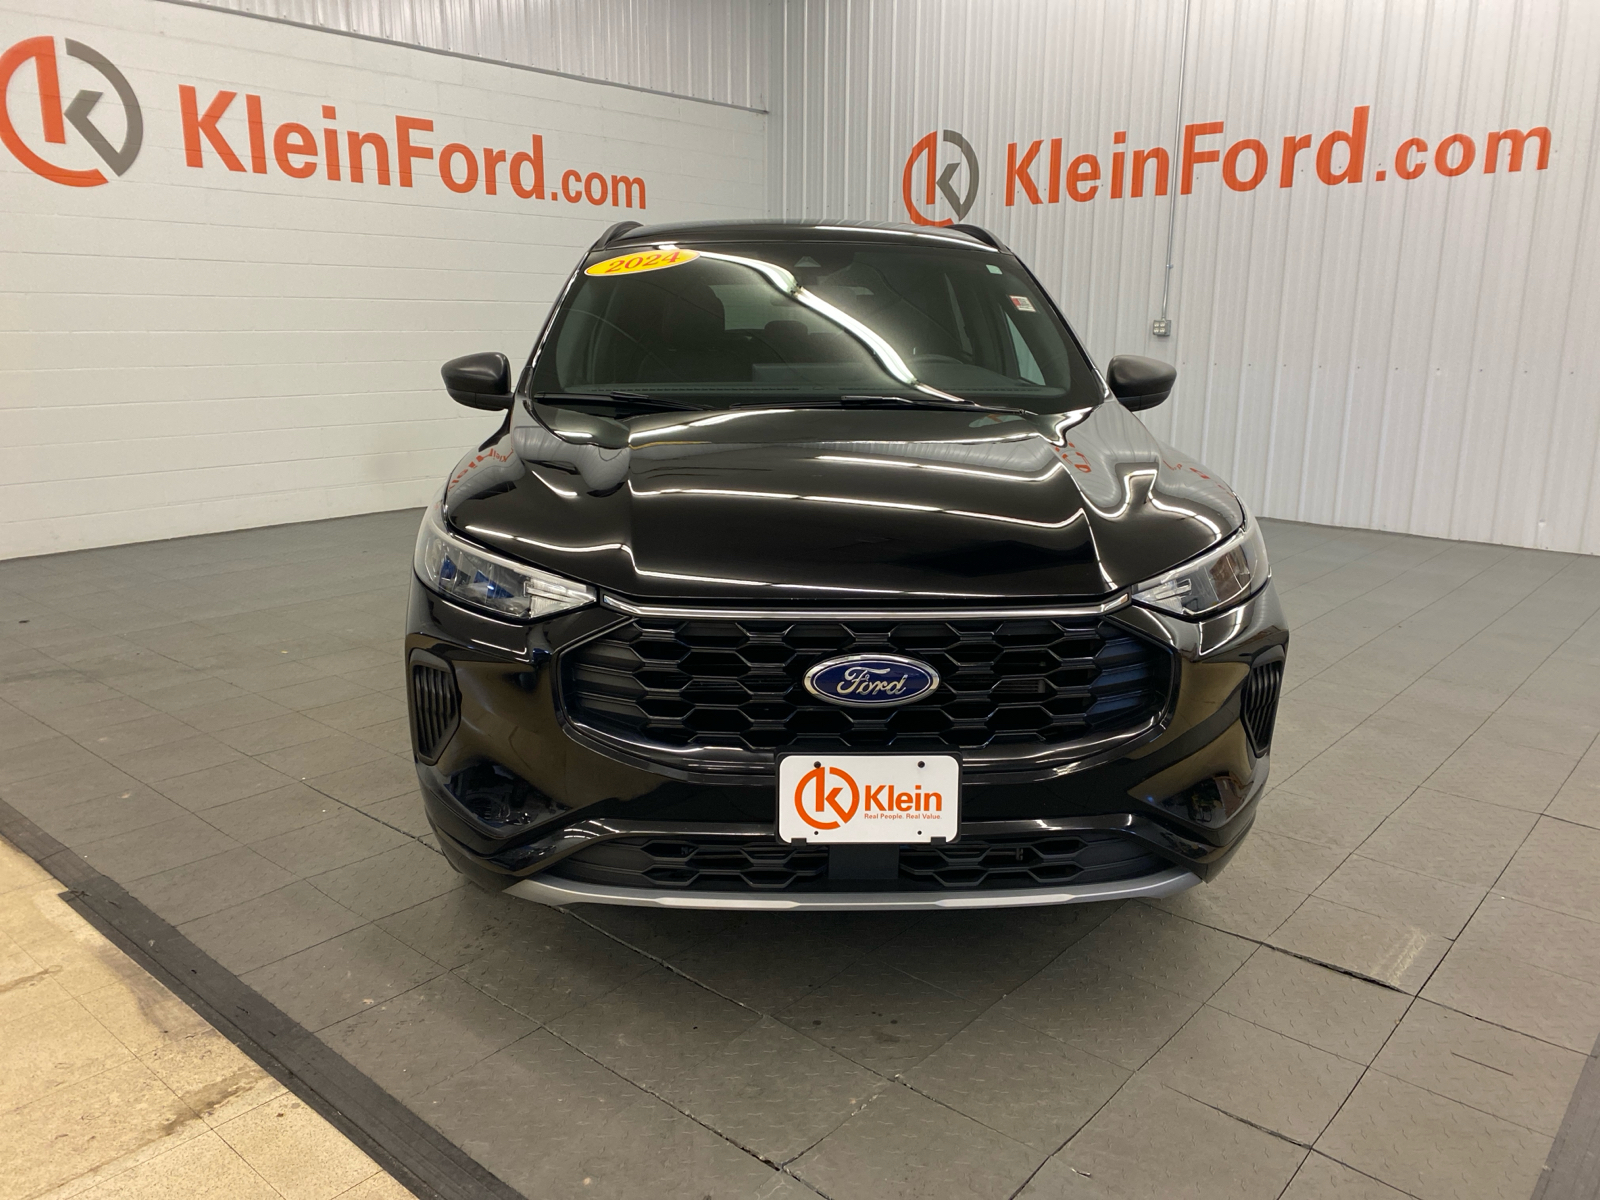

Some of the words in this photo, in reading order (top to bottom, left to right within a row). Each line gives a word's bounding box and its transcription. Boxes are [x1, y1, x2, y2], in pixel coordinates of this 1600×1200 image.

[178, 84, 647, 210] KleinFord.com
[1004, 105, 1552, 207] KleinFord.com
[605, 251, 680, 274] 2024
[836, 666, 908, 696] Ford
[864, 784, 943, 812] Klein
[880, 813, 905, 821] People.
